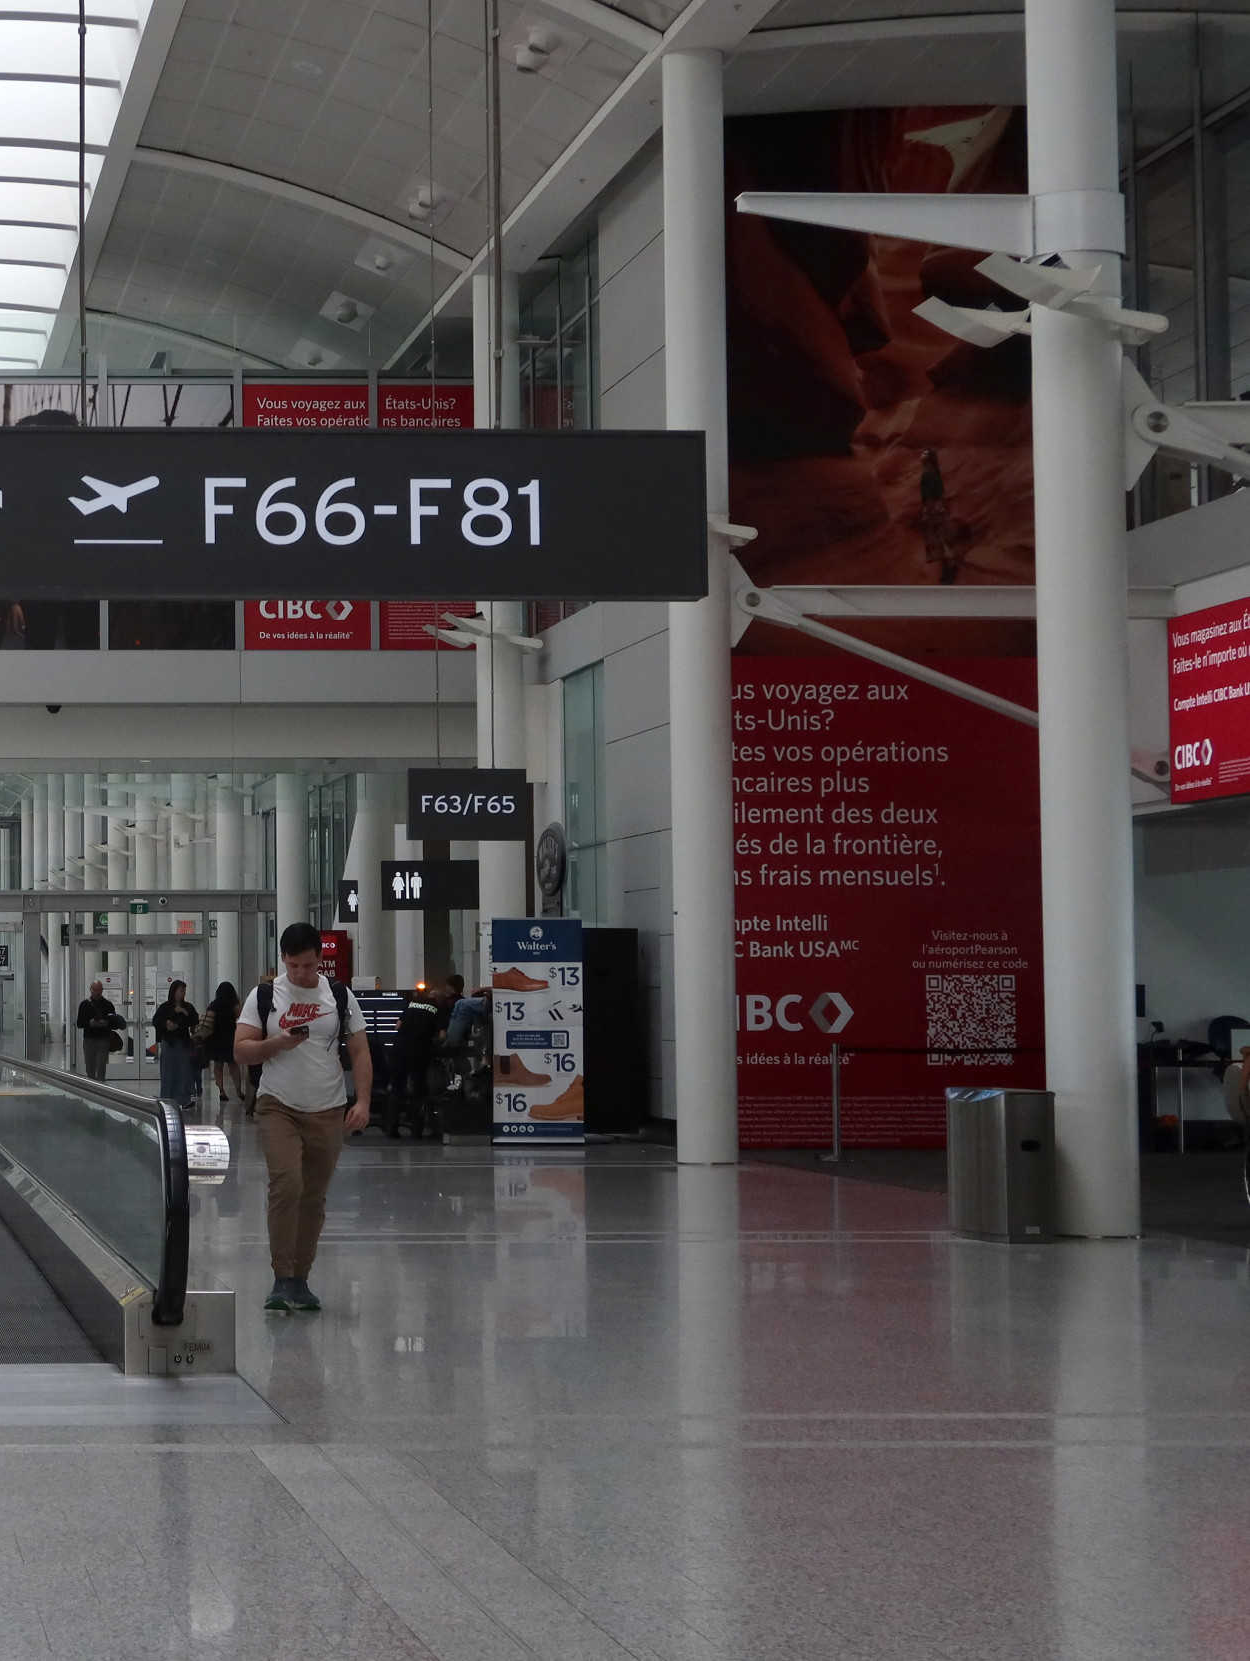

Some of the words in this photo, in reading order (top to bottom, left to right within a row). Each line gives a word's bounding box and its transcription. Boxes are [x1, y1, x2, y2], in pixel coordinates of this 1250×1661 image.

[256, 397, 288, 410] Vous
[290, 399, 341, 413] voyagez
[343, 400, 366, 410] aux
[385, 395, 456, 410] États-Unis?
[257, 414, 293, 427] Faites
[296, 418, 317, 427] vos
[400, 416, 461, 428] bancaires
[204, 476, 541, 547] F66-F81
[259, 600, 323, 619] CIBC
[259, 631, 270, 639] De
[287, 630, 308, 640] idées
[309, 631, 315, 640] à
[316, 630, 324, 640] la
[1172, 632, 1190, 648] Vous
[1190, 622, 1228, 644] magasinez
[1229, 618, 1242, 634] aux
[1173, 652, 1202, 675] Faites-le
[1238, 641, 1247, 658] où
[731, 684, 755, 700] us
[762, 684, 859, 705] voyagez
[866, 684, 909, 700] aux
[1174, 696, 1196, 712] Compte
[1196, 690, 1213, 706] Intelli
[1213, 686, 1228, 703] CIBC
[1228, 683, 1244, 700] Bank
[734, 709, 835, 731] ts-Unis?
[732, 742, 766, 762] tes
[773, 745, 813, 762] vos
[821, 740, 949, 766] opérations
[1174, 741, 1201, 770] CIBC
[732, 772, 813, 793] ncaires
[820, 771, 870, 797] plus
[421, 793, 516, 816] F63/F65
[734, 802, 824, 824] ilement
[831, 802, 873, 824] des
[880, 802, 938, 824] deux
[769, 833, 798, 855] de
[806, 833, 826, 855] la
[833, 833, 944, 858] frontière,
[759, 863, 812, 886] frais
[776, 914, 828, 932] Intelli
[931, 930, 998, 941] Visitez-nous
[1001, 931, 1008, 941] à
[517, 941, 557, 951] Walter's
[750, 940, 794, 958] Bank
[912, 961, 926, 969] ou
[928, 958, 984, 969] numérisez
[987, 961, 999, 969] ce
[1002, 958, 1029, 969] code
[549, 966, 580, 986] $13
[287, 1002, 321, 1017] NIKE
[495, 1001, 525, 1021] $13
[735, 993, 804, 1032] BC
[544, 1053, 576, 1073] $16
[746, 1052, 780, 1065] idées
[783, 1053, 791, 1065] à
[794, 1052, 806, 1065] la
[495, 1093, 527, 1113] $16
[183, 1342, 210, 1352] FEM04
